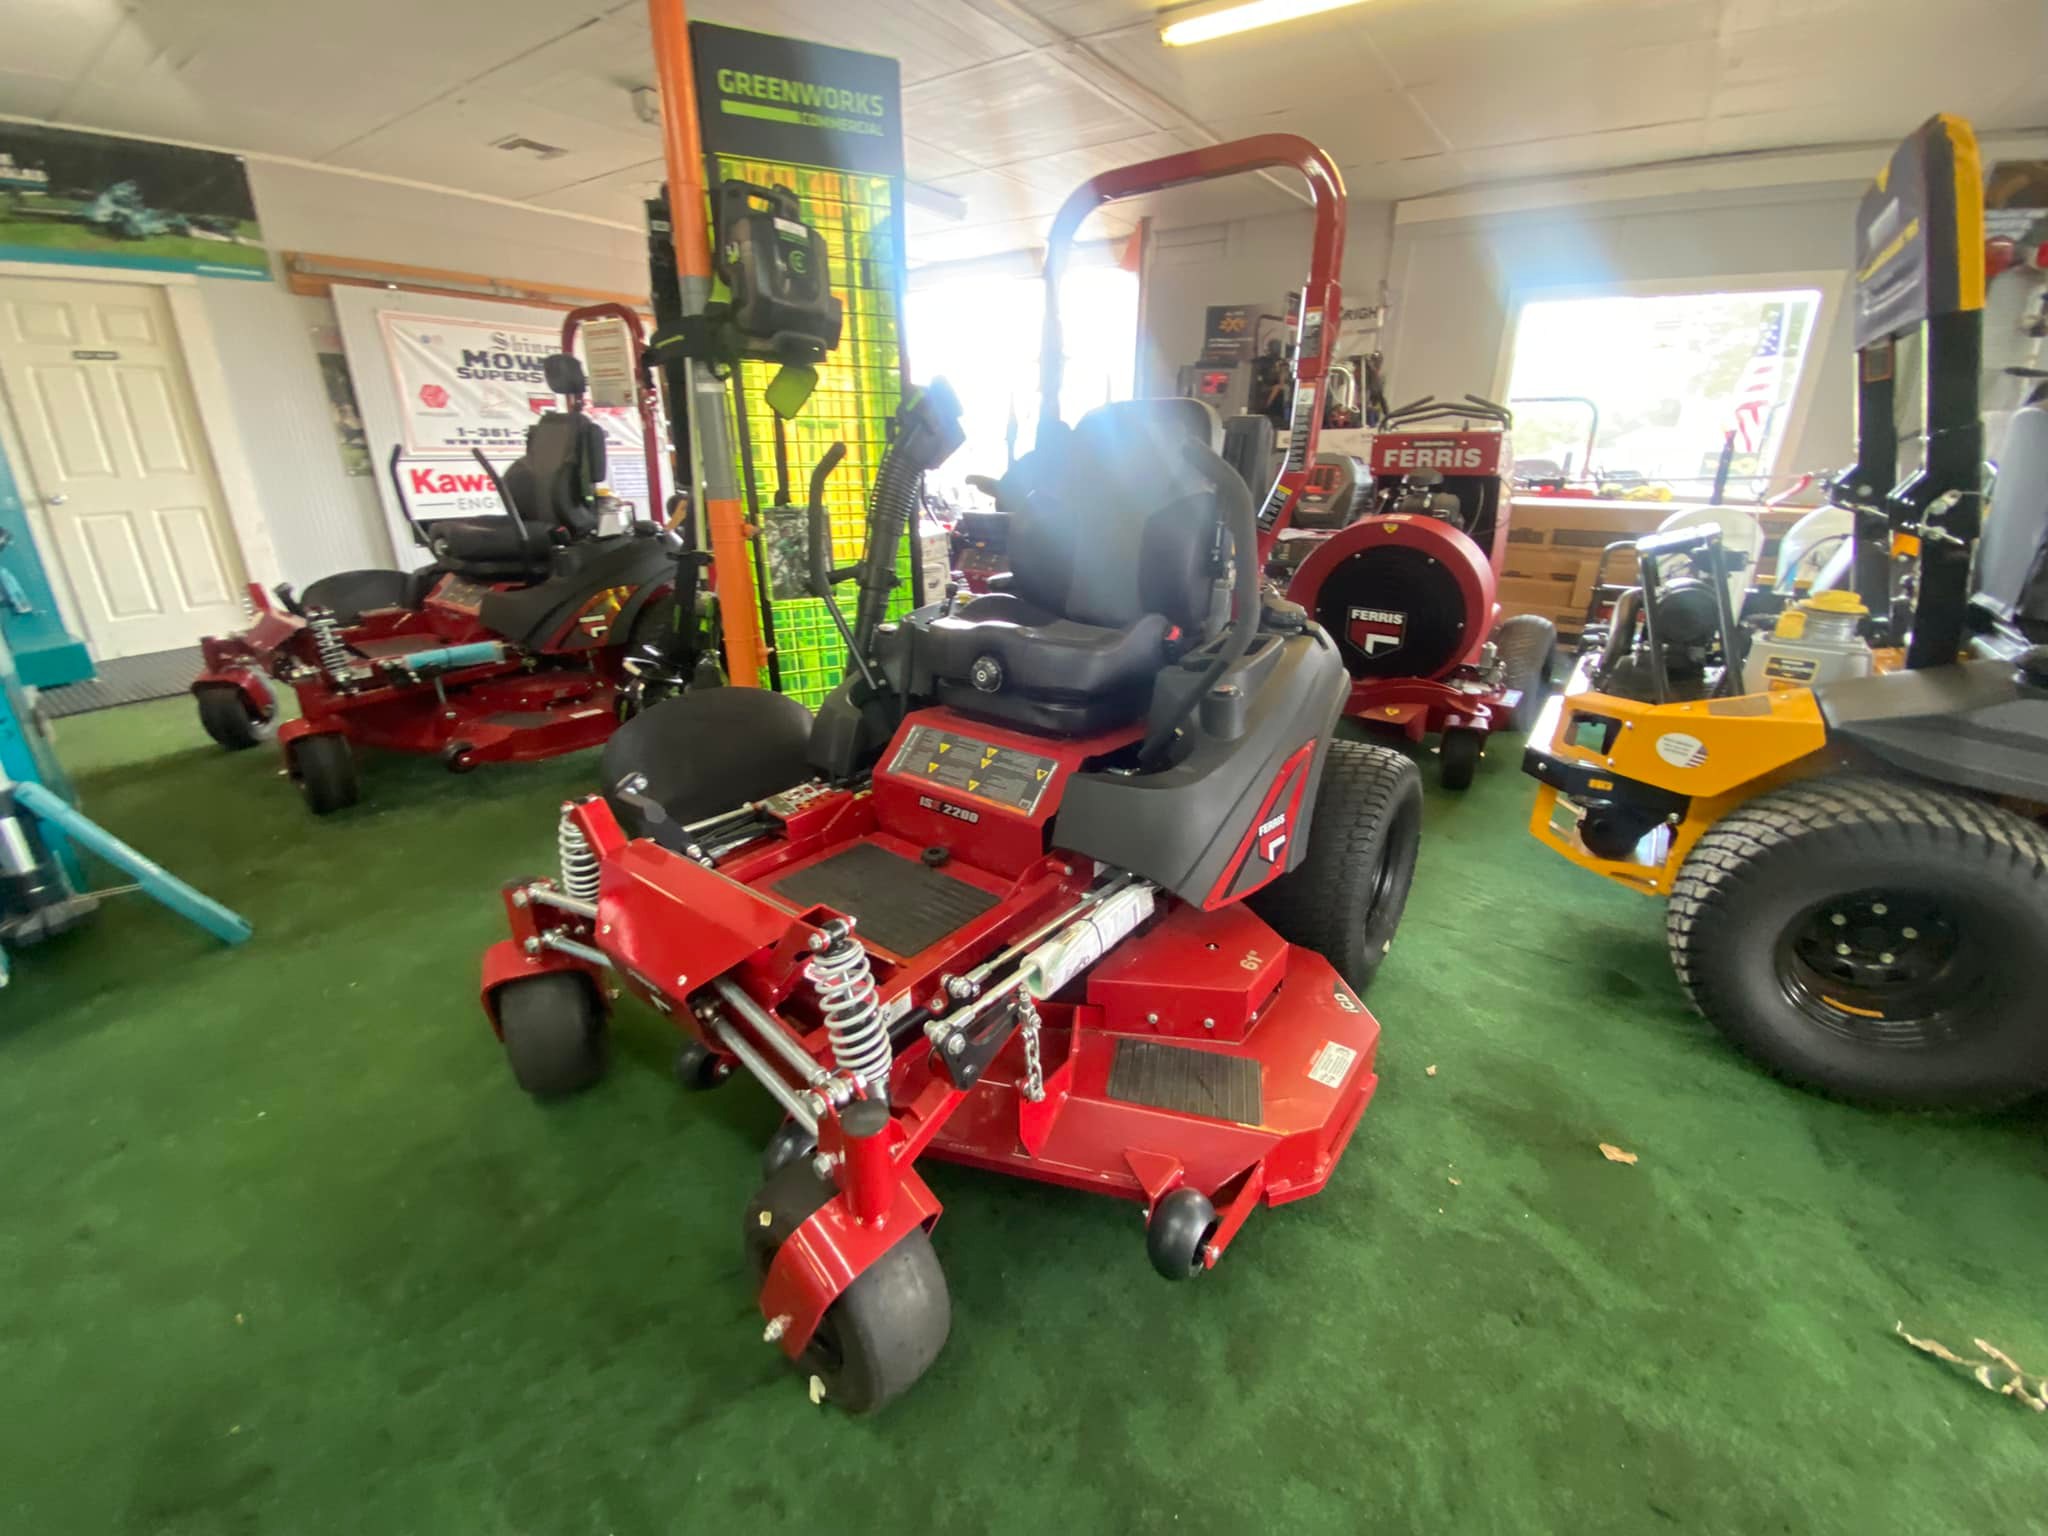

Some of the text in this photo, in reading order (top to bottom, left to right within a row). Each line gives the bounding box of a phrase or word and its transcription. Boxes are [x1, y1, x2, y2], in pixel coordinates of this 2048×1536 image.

[717, 68, 884, 117] GREENWORKS
[462, 348, 545, 371] MOW
[457, 367, 545, 383] SUPERS
[1383, 448, 1482, 468] FERRIS
[410, 468, 497, 494] Kawa
[1351, 608, 1404, 625] FERRIS
[1258, 813, 1286, 837] FERRIS
